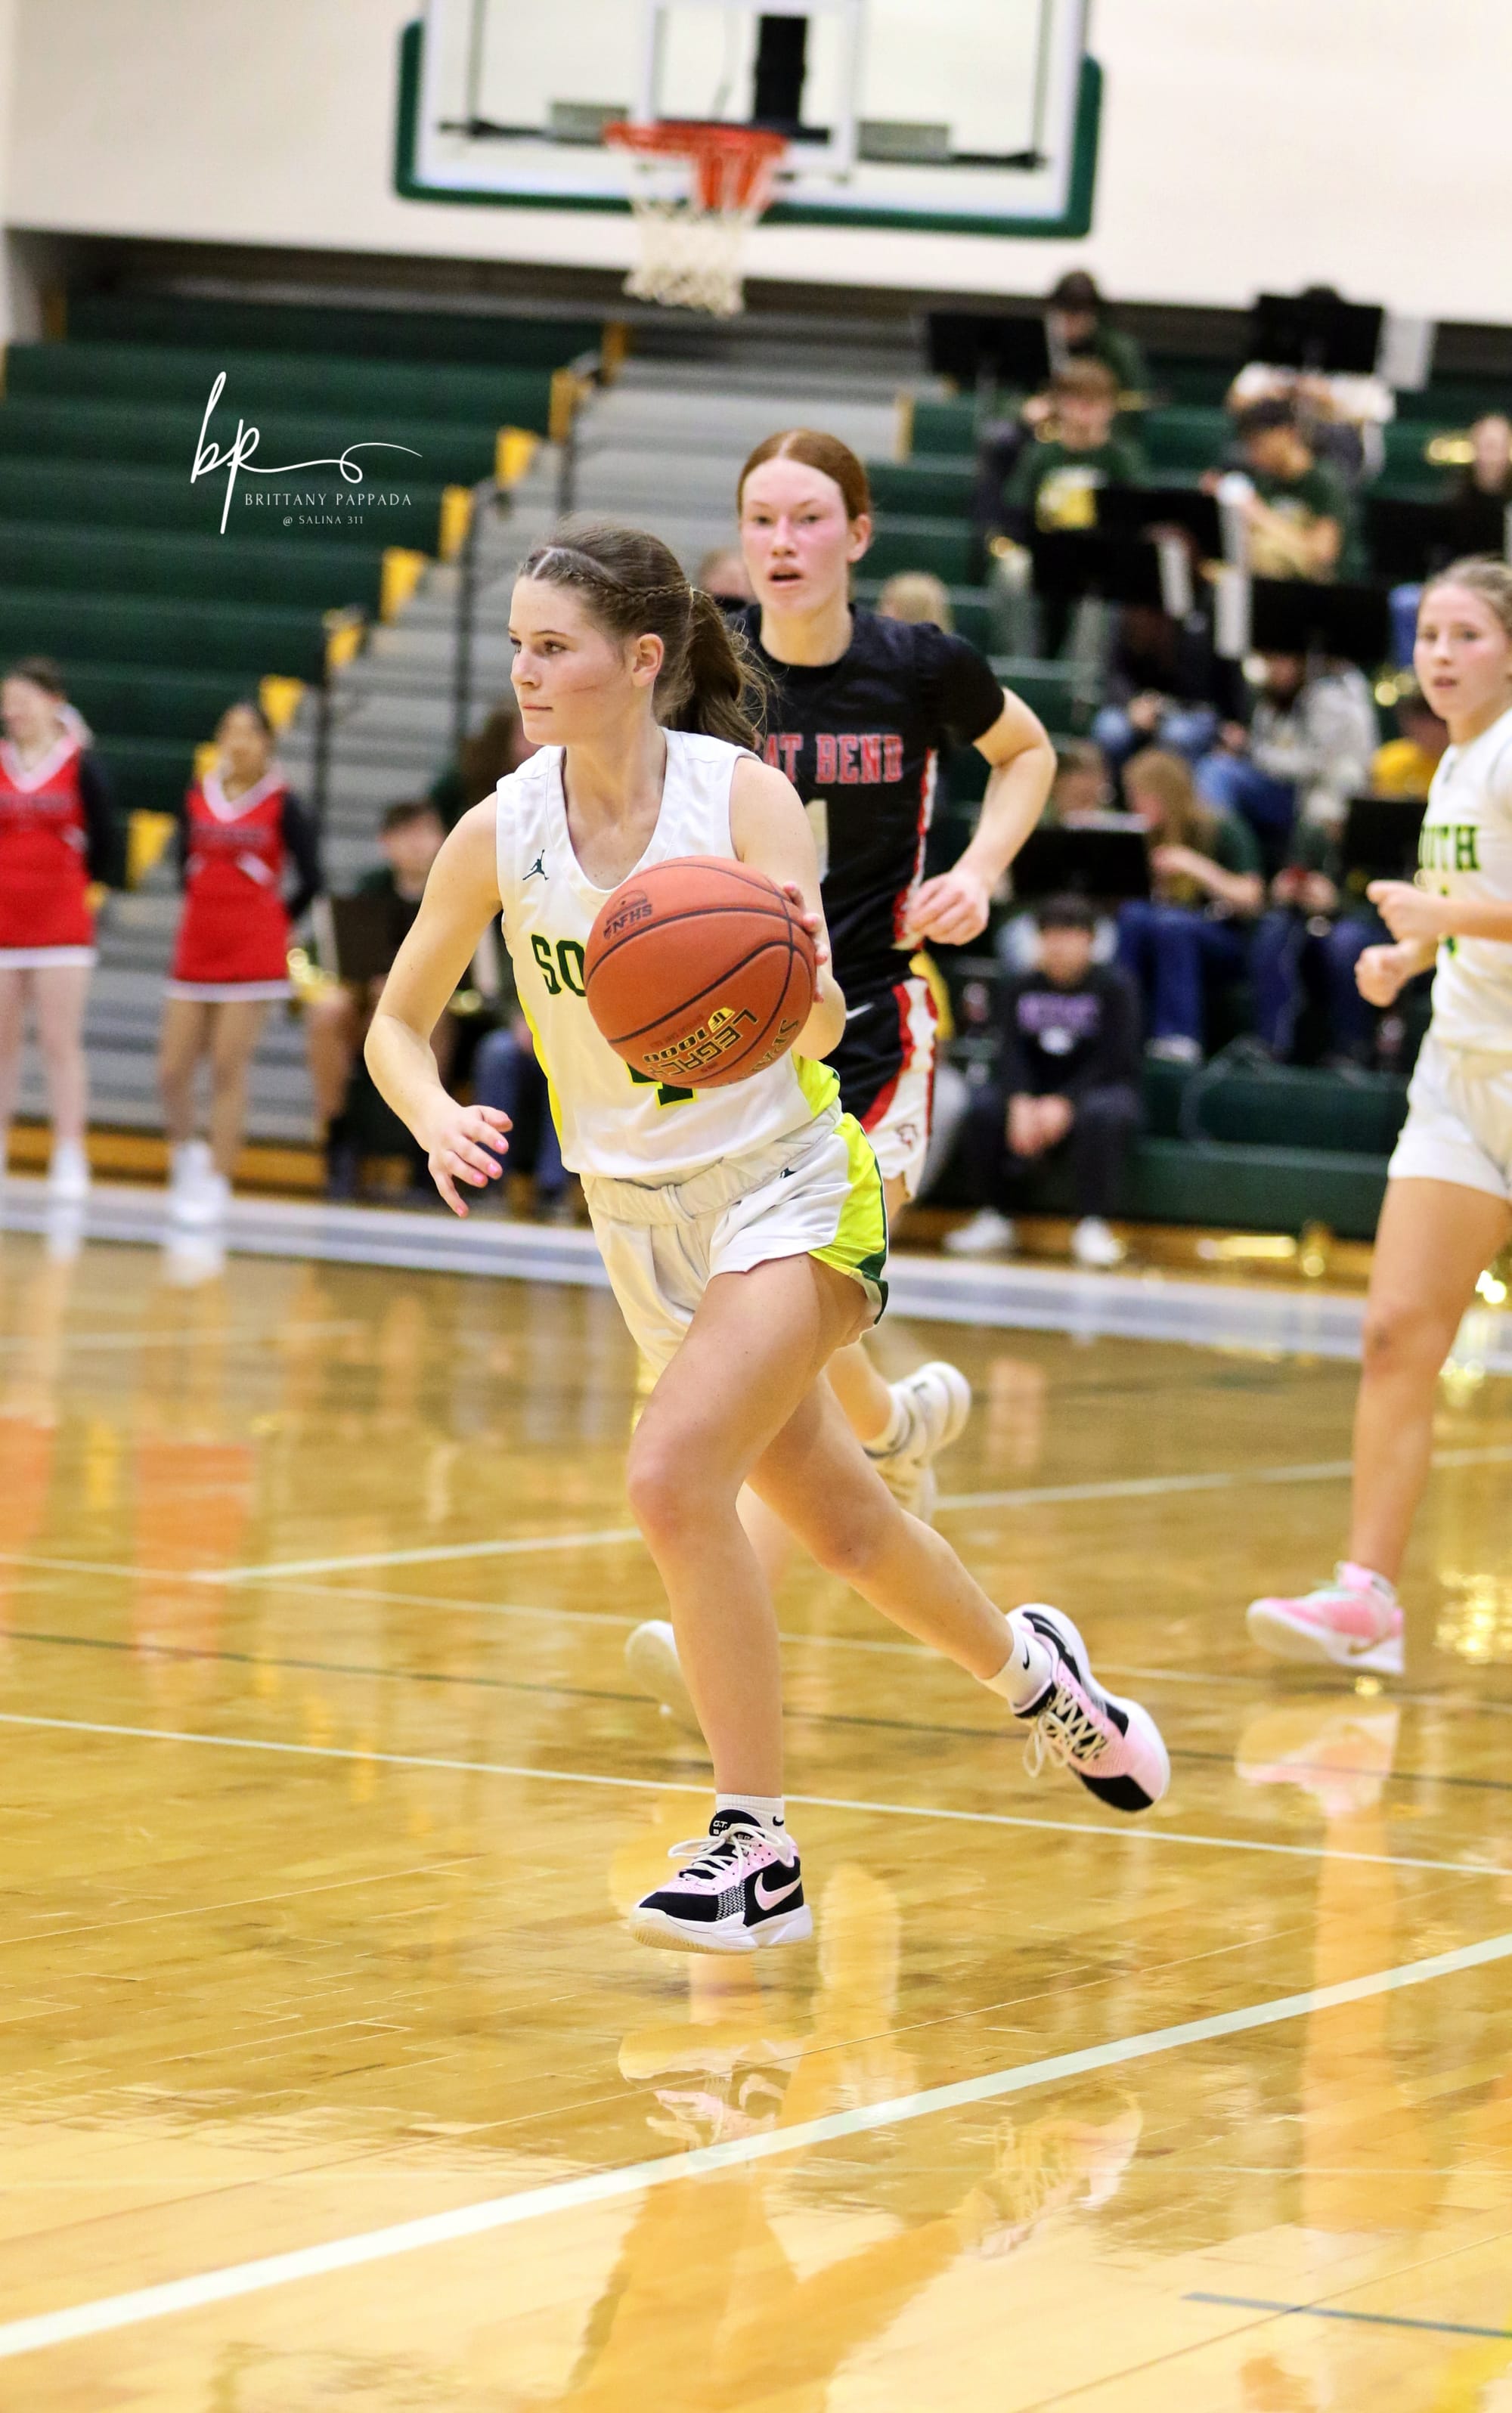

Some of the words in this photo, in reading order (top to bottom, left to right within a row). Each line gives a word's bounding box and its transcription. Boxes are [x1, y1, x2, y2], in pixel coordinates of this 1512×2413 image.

[756, 733, 804, 783] AT
[815, 733, 903, 785] BEND
[612, 903, 653, 934] NFHS
[709, 1009, 730, 1031] TF
[643, 1026, 710, 1064] 1000
[648, 1008, 759, 1077] LEGACY
[713, 1820, 728, 1829] G.T.
